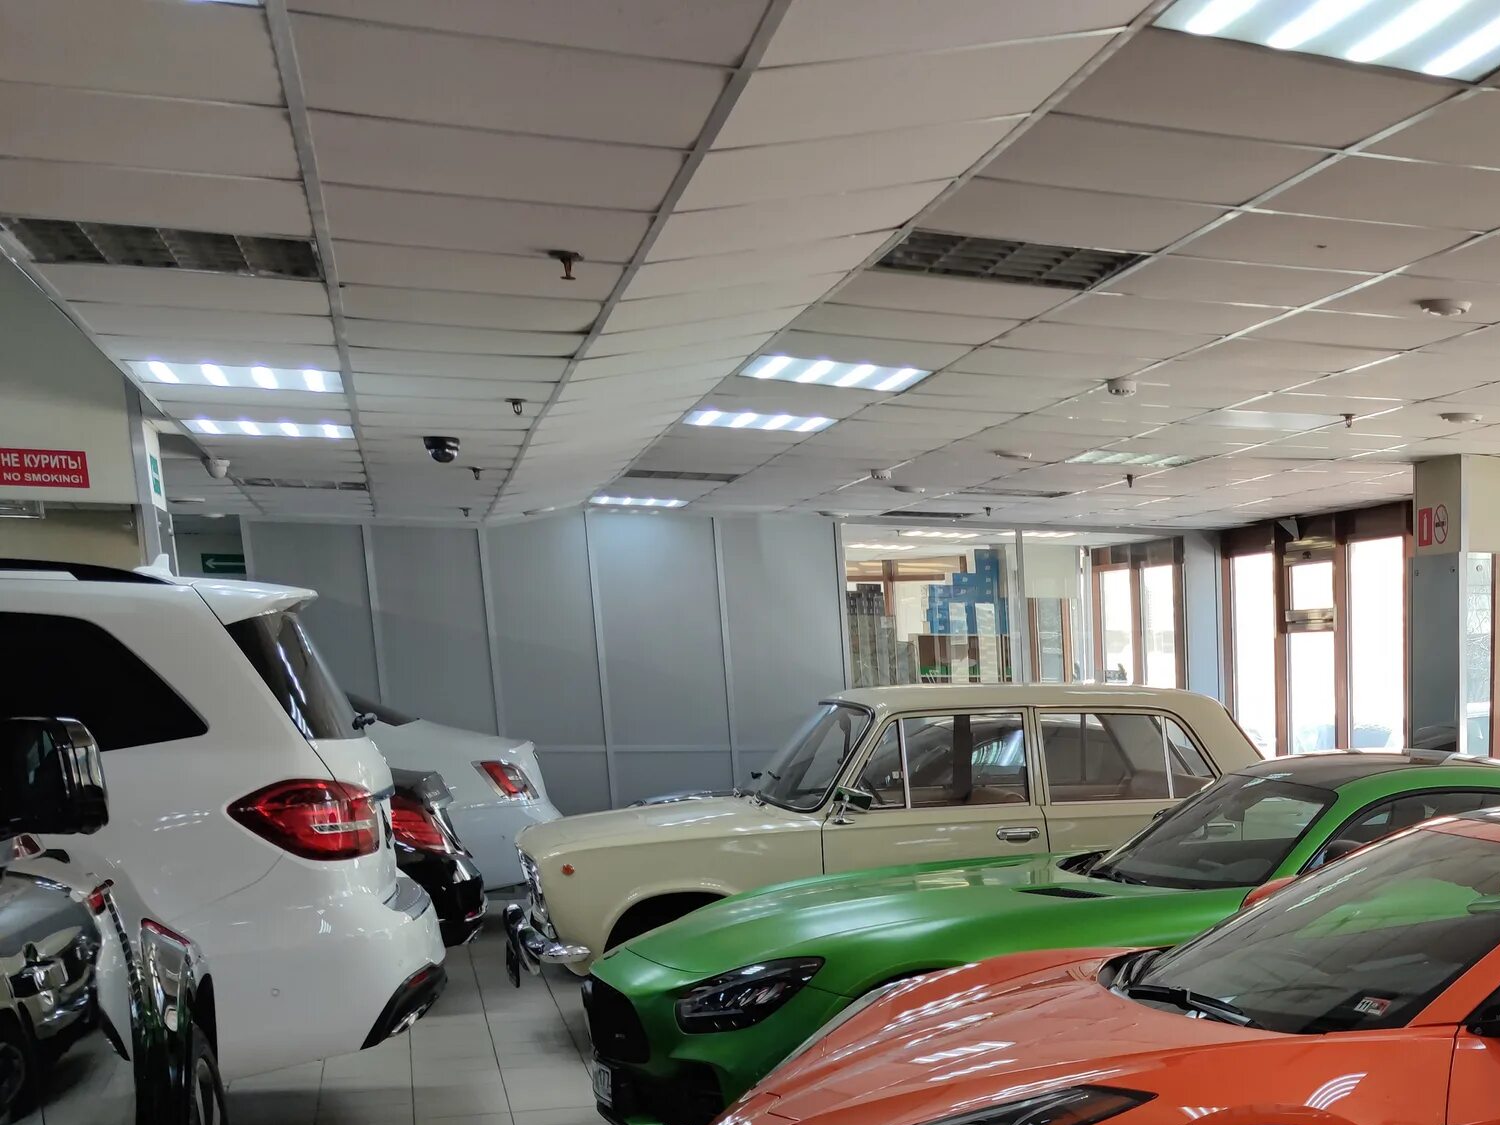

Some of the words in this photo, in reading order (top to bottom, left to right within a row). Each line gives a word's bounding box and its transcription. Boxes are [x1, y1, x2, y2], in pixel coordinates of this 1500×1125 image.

[1, 453, 20, 468] НЕ
[24, 453, 82, 470] КУРИТЬ!
[3, 472, 21, 482] NO
[24, 472, 83, 484] SMOKING!
